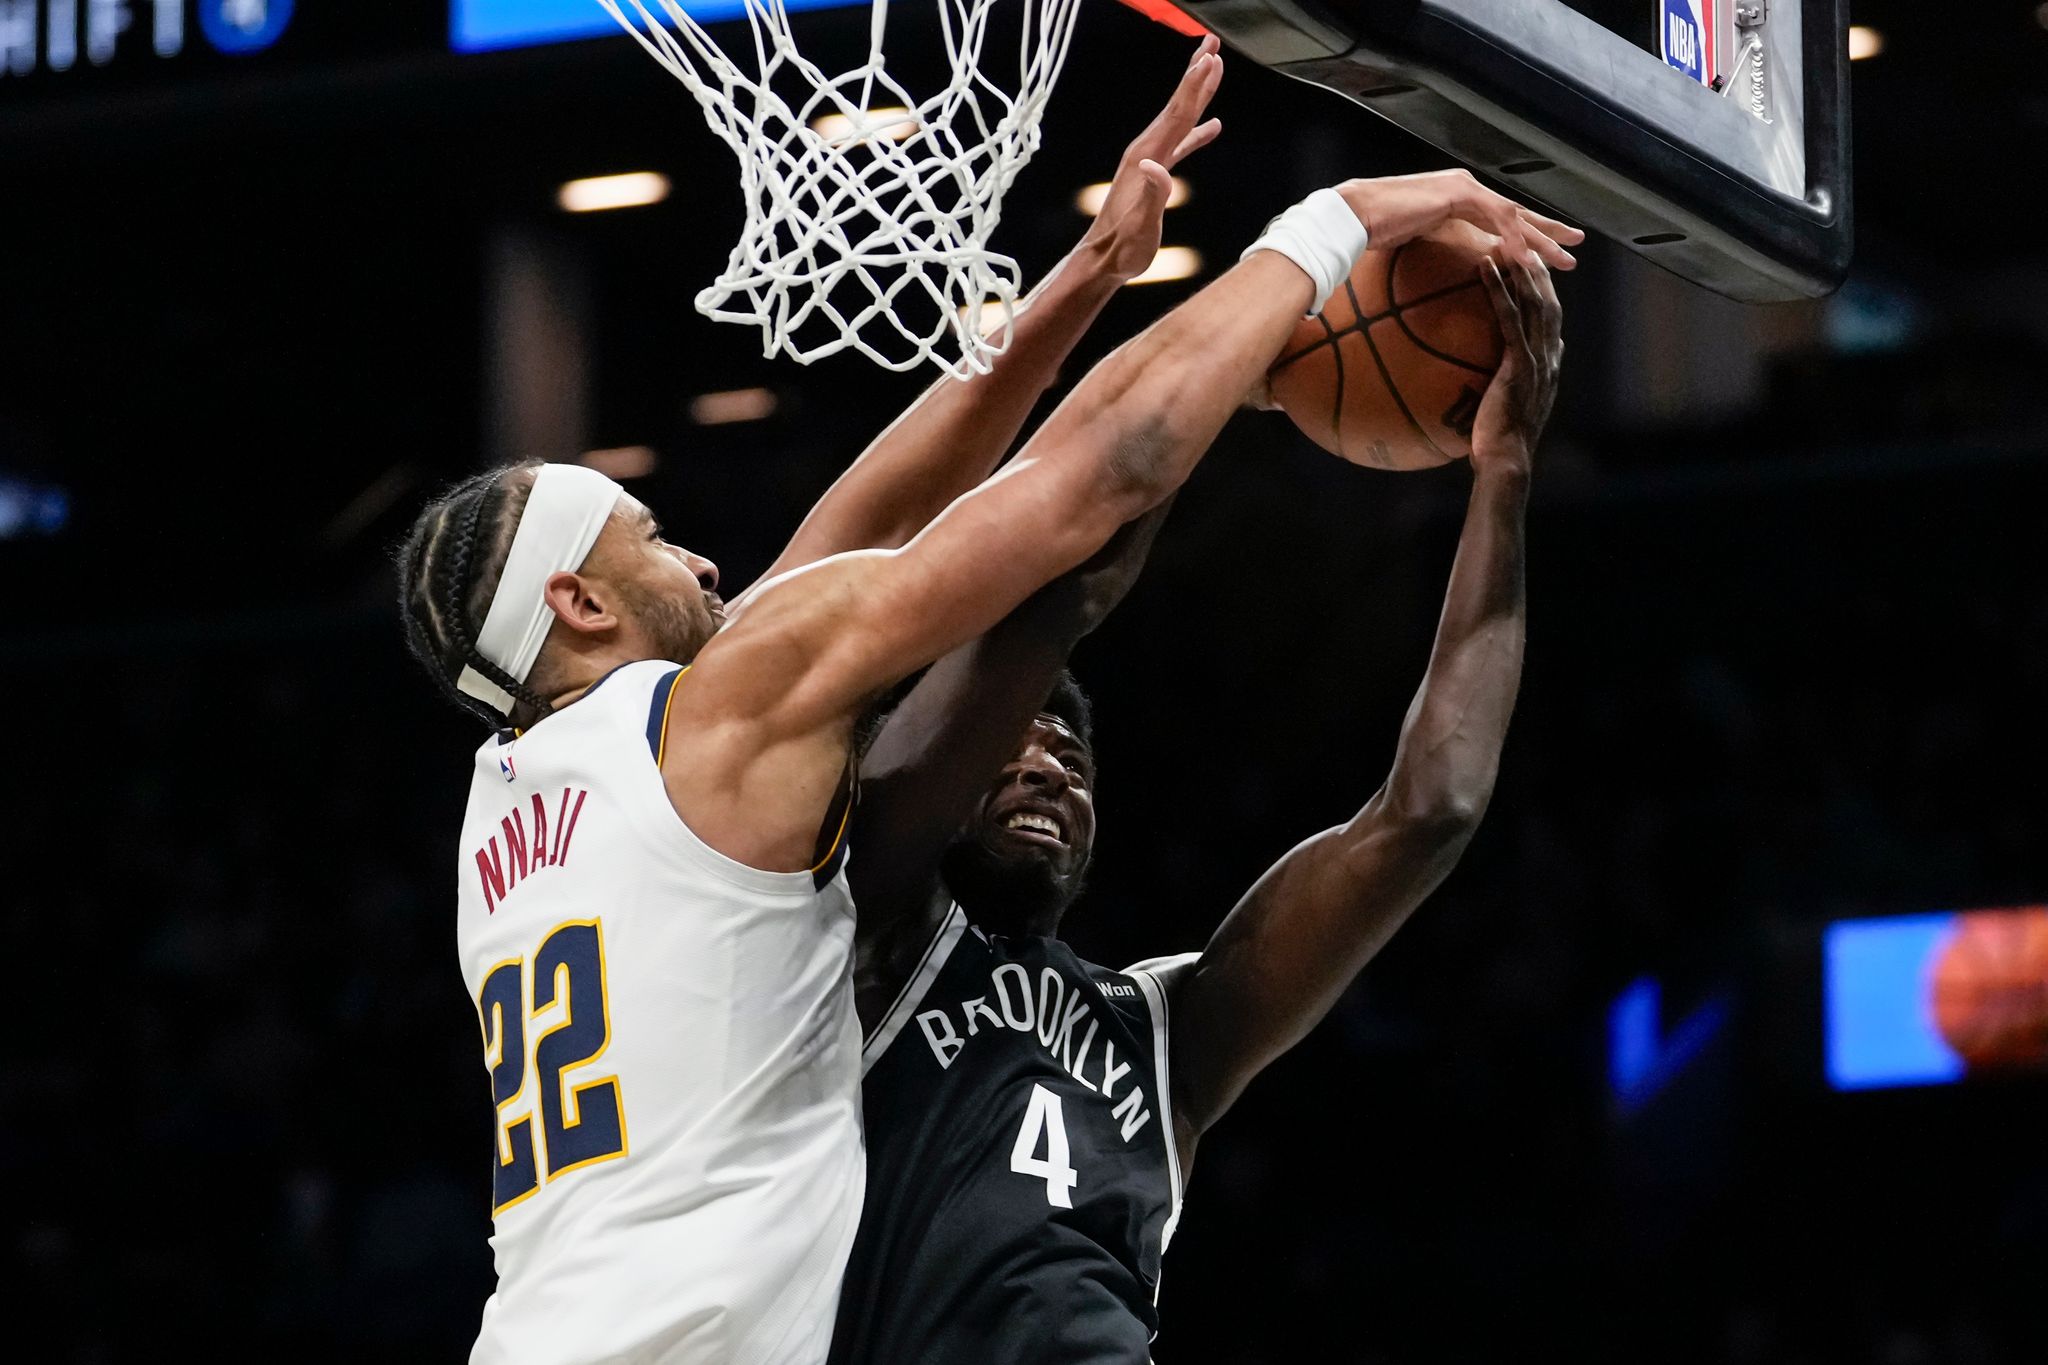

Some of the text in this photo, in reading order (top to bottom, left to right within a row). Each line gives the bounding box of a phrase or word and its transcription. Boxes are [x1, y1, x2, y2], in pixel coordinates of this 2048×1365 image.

[1669, 12, 1697, 71] NBA
[475, 787, 587, 916] NNAJI
[916, 963, 1151, 1143] BROOKLYN
[1096, 982, 1136, 997] Won
[478, 915, 629, 1221] 22
[1010, 1083, 1078, 1209] 4
